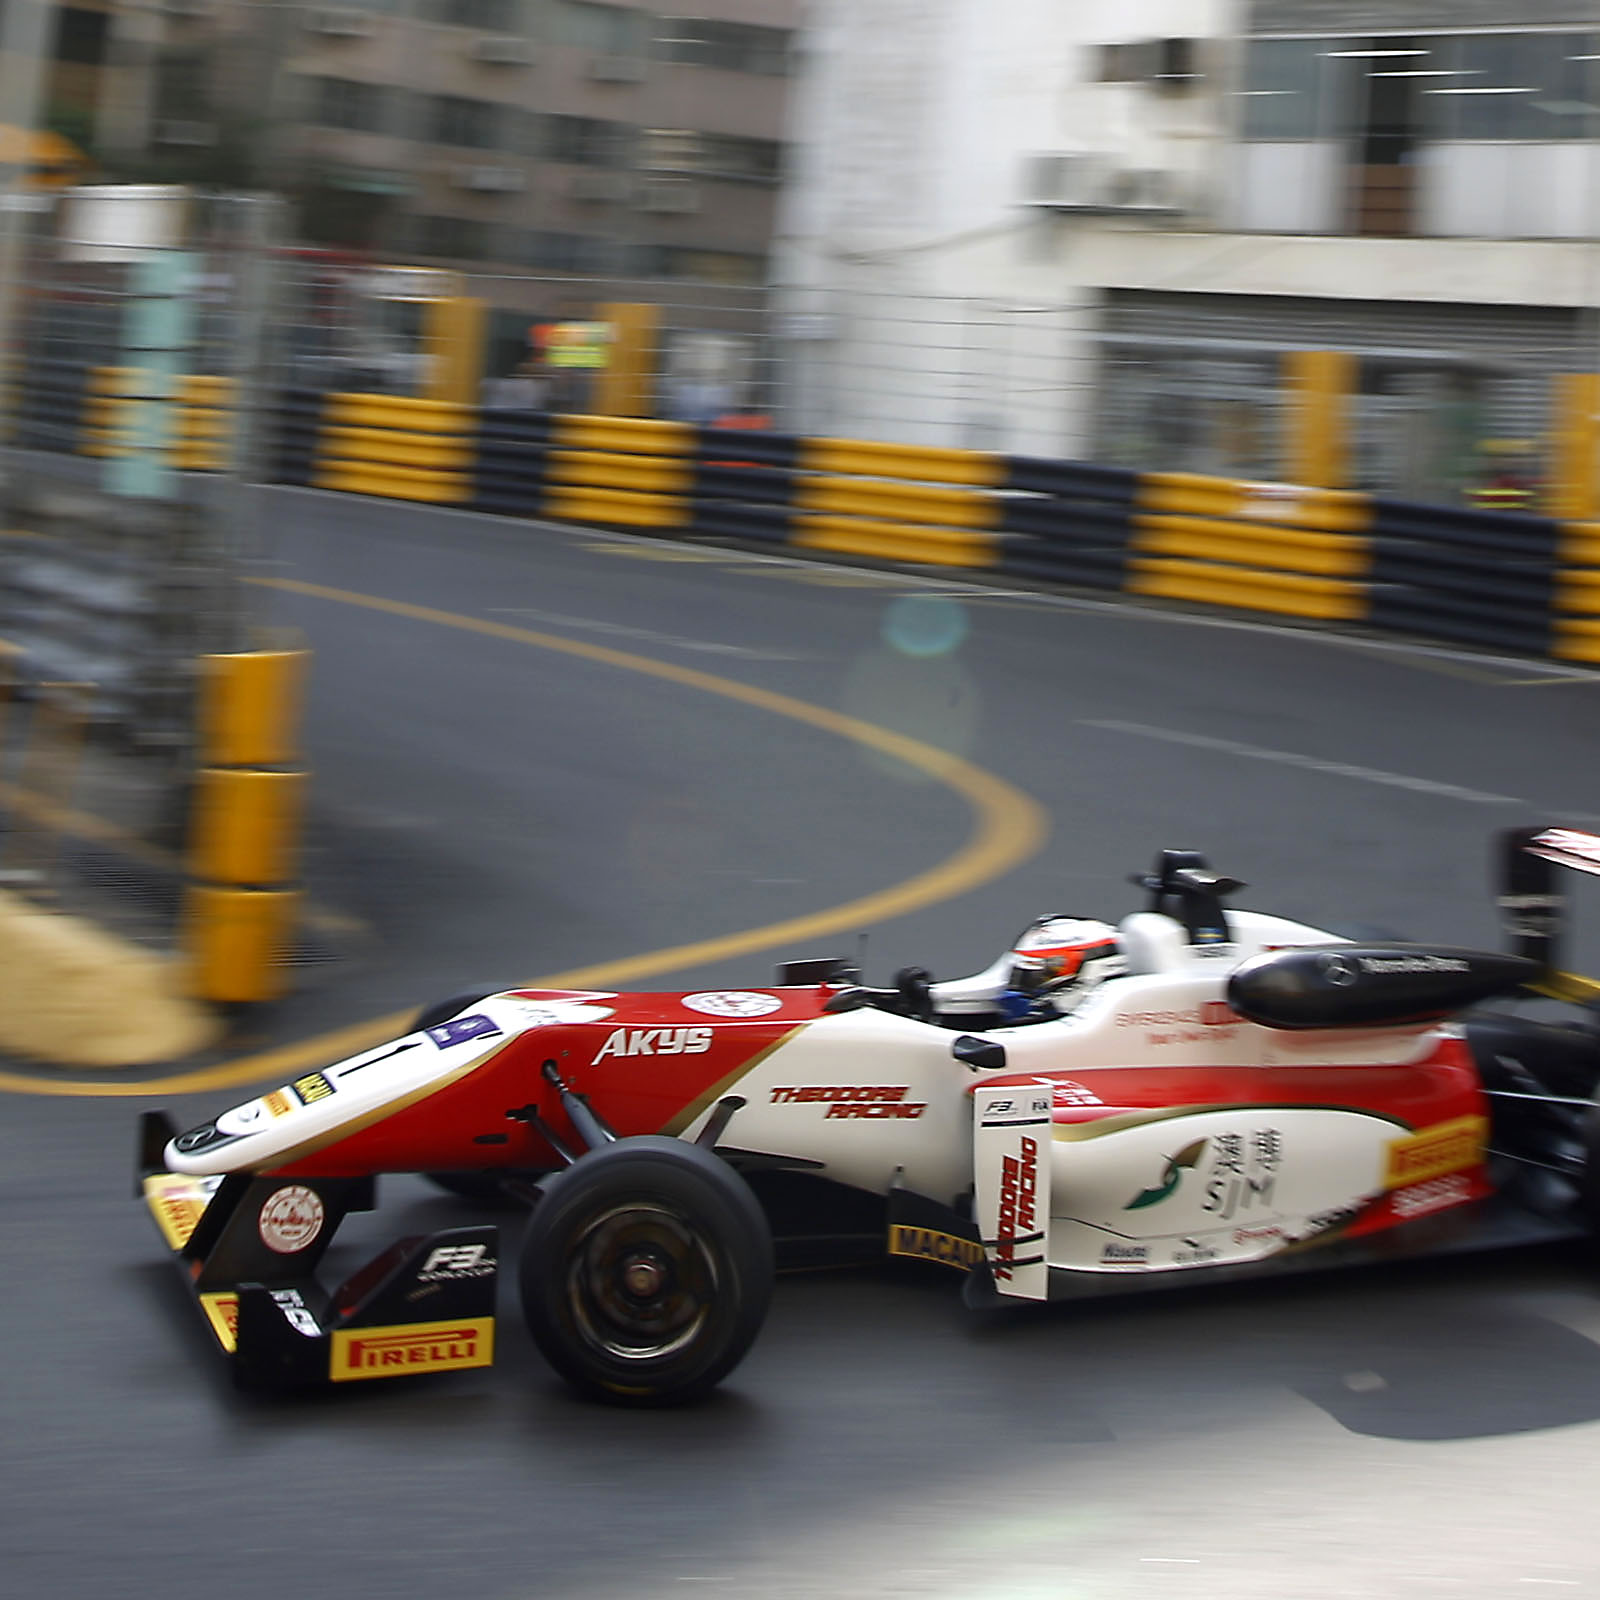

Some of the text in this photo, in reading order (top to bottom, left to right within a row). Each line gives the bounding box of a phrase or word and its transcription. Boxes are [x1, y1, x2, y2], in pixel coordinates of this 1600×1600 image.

[590, 1028, 713, 1066] AKYS
[769, 1086, 910, 1104] THEODORE
[824, 1103, 928, 1119] RACING
[1018, 1135, 1038, 1231] RACING
[422, 1244, 487, 1272] F3
[348, 1329, 477, 1368] PIRELLI
